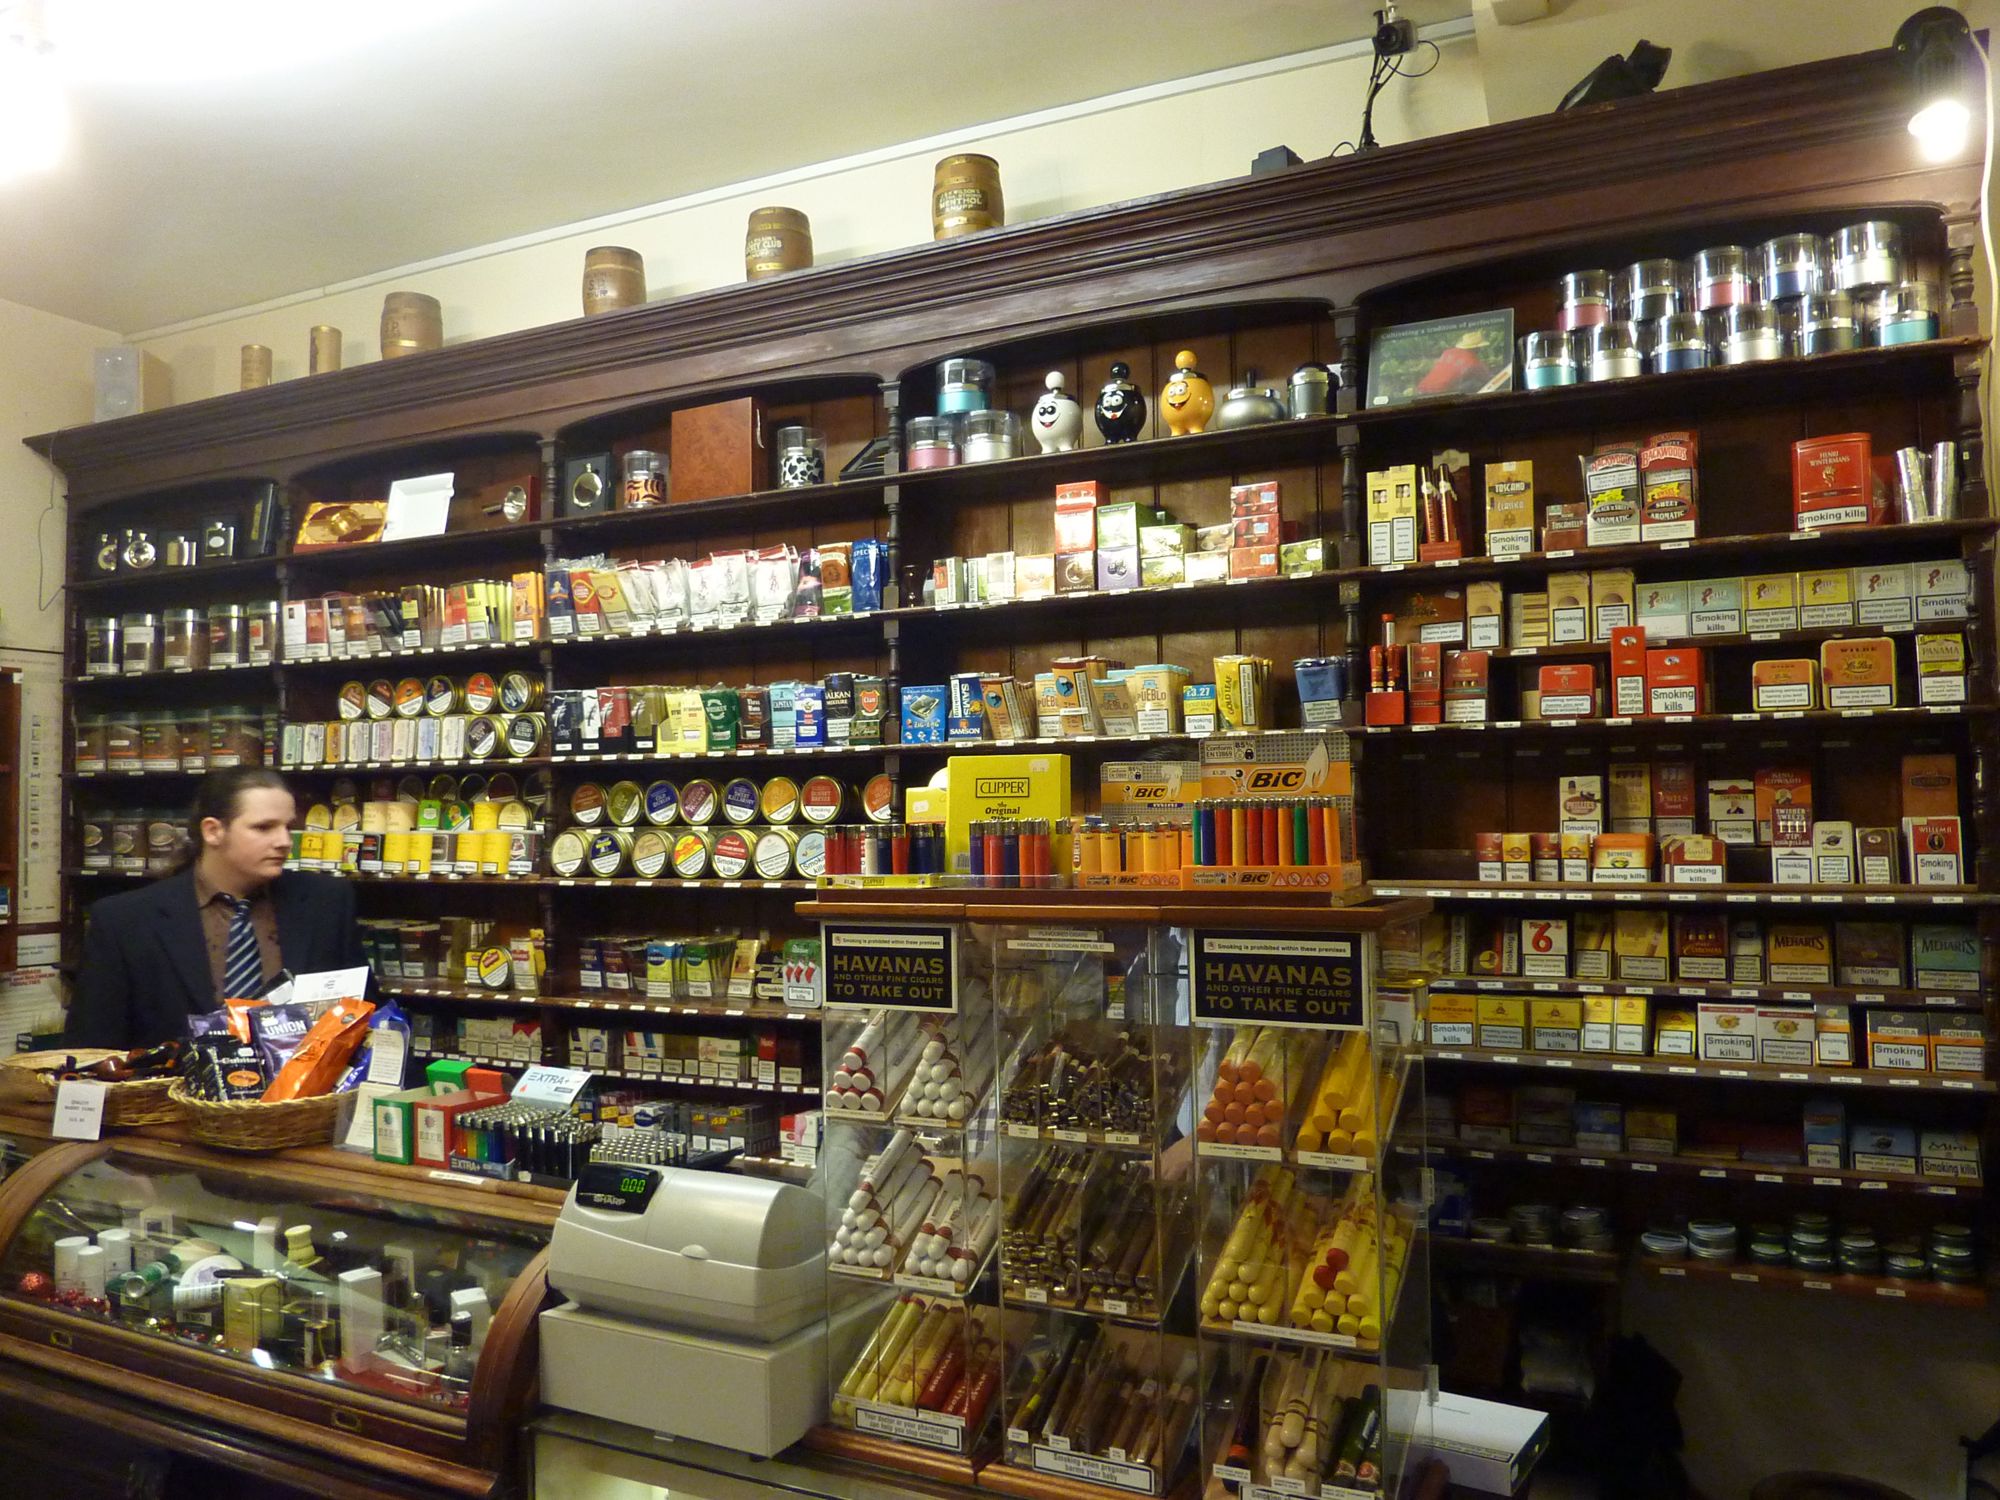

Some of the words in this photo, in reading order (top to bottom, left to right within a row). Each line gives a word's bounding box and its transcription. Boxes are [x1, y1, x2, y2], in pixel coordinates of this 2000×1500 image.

[940, 197, 982, 209] MENTHOL
[763, 239, 782, 248] CLUB
[1641, 445, 1688, 469] BACKWOODS
[1820, 450, 1839, 458] HENRI
[1495, 482, 1525, 493] TOSCANO
[1656, 500, 1678, 508] SWEET
[1596, 515, 1629, 524] AROMATIC
[1650, 510, 1684, 520] AROMATIC
[1798, 511, 1842, 525] Smoking
[1844, 509, 1866, 518] kills
[1492, 534, 1529, 544] Smoking
[1501, 544, 1520, 552] Kills
[1921, 598, 1967, 607] Smoking
[1696, 613, 1736, 623] Smoking
[1934, 609, 1955, 617] kills
[1556, 615, 1583, 623] Smoking
[1707, 623, 1725, 632] kills
[1922, 646, 1960, 656] PANAMA
[1137, 689, 1167, 702] PUEBLO
[1652, 689, 1694, 700] Smoking
[1664, 701, 1683, 711] kills
[950, 727, 981, 735] SAMSON
[1206, 743, 1233, 751] Conform
[980, 781, 1025, 794] CLIPPER
[985, 806, 1021, 815] Original
[1565, 824, 1597, 832] Smoking
[717, 858, 743, 868] Smoking
[1921, 858, 1954, 870] Smoking
[723, 866, 735, 874] kills
[1679, 867, 1717, 876] Smoking
[1929, 872, 1946, 881] kills
[868, 938, 891, 946] prohibited
[1532, 922, 1553, 953] 6
[1217, 943, 1243, 951] Smoking
[1250, 944, 1280, 952] prohibited
[1505, 936, 1515, 972] Smoking
[833, 955, 945, 974] HAVANAS
[853, 974, 884, 982] OTHER
[886, 975, 907, 983] FINE
[910, 976, 944, 984] CIGARS
[1205, 962, 1352, 986] HAVANAS
[833, 983, 855, 996] TO
[860, 984, 904, 998] TAKE
[908, 986, 944, 999] OUT
[1206, 984, 1229, 993] AND
[1232, 985, 1271, 995] OTHER
[1275, 986, 1304, 996] FINE
[1306, 988, 1352, 998] CIGARS
[1205, 995, 1234, 1010] TO
[1240, 996, 1298, 1013] TAKE
[1305, 999, 1352, 1016] OUT
[264, 1020, 307, 1035] UNION
[1432, 1025, 1472, 1034] Smoking
[1443, 1035, 1461, 1043] kills
[1536, 1030, 1578, 1040] Smoking
[1941, 1030, 1980, 1038] COHIBA
[1547, 1040, 1566, 1048] kills
[1708, 1036, 1752, 1047] Smoking
[1719, 1048, 1740, 1057] kills
[1876, 1045, 1924, 1057] Smoking
[1888, 1057, 1912, 1067] kills
[451, 1158, 481, 1172] EXTRA+
[1925, 1161, 1959, 1177] Smoking
[1960, 1164, 1976, 1176] kills
[594, 1194, 626, 1206] SHARP
[864, 1412, 877, 1420] Your
[903, 1420, 916, 1429] your
[917, 1422, 950, 1436] pharmacist
[881, 1423, 894, 1432] help
[894, 1426, 905, 1435] you
[906, 1427, 918, 1437] stop
[919, 1430, 944, 1443] smoking
[1054, 1453, 1081, 1467] Smoking
[1082, 1459, 1100, 1469] when
[1101, 1462, 1130, 1475] pregnant
[1065, 1464, 1085, 1475] harms
[1086, 1468, 1101, 1477] your
[1102, 1470, 1118, 1482] baby
